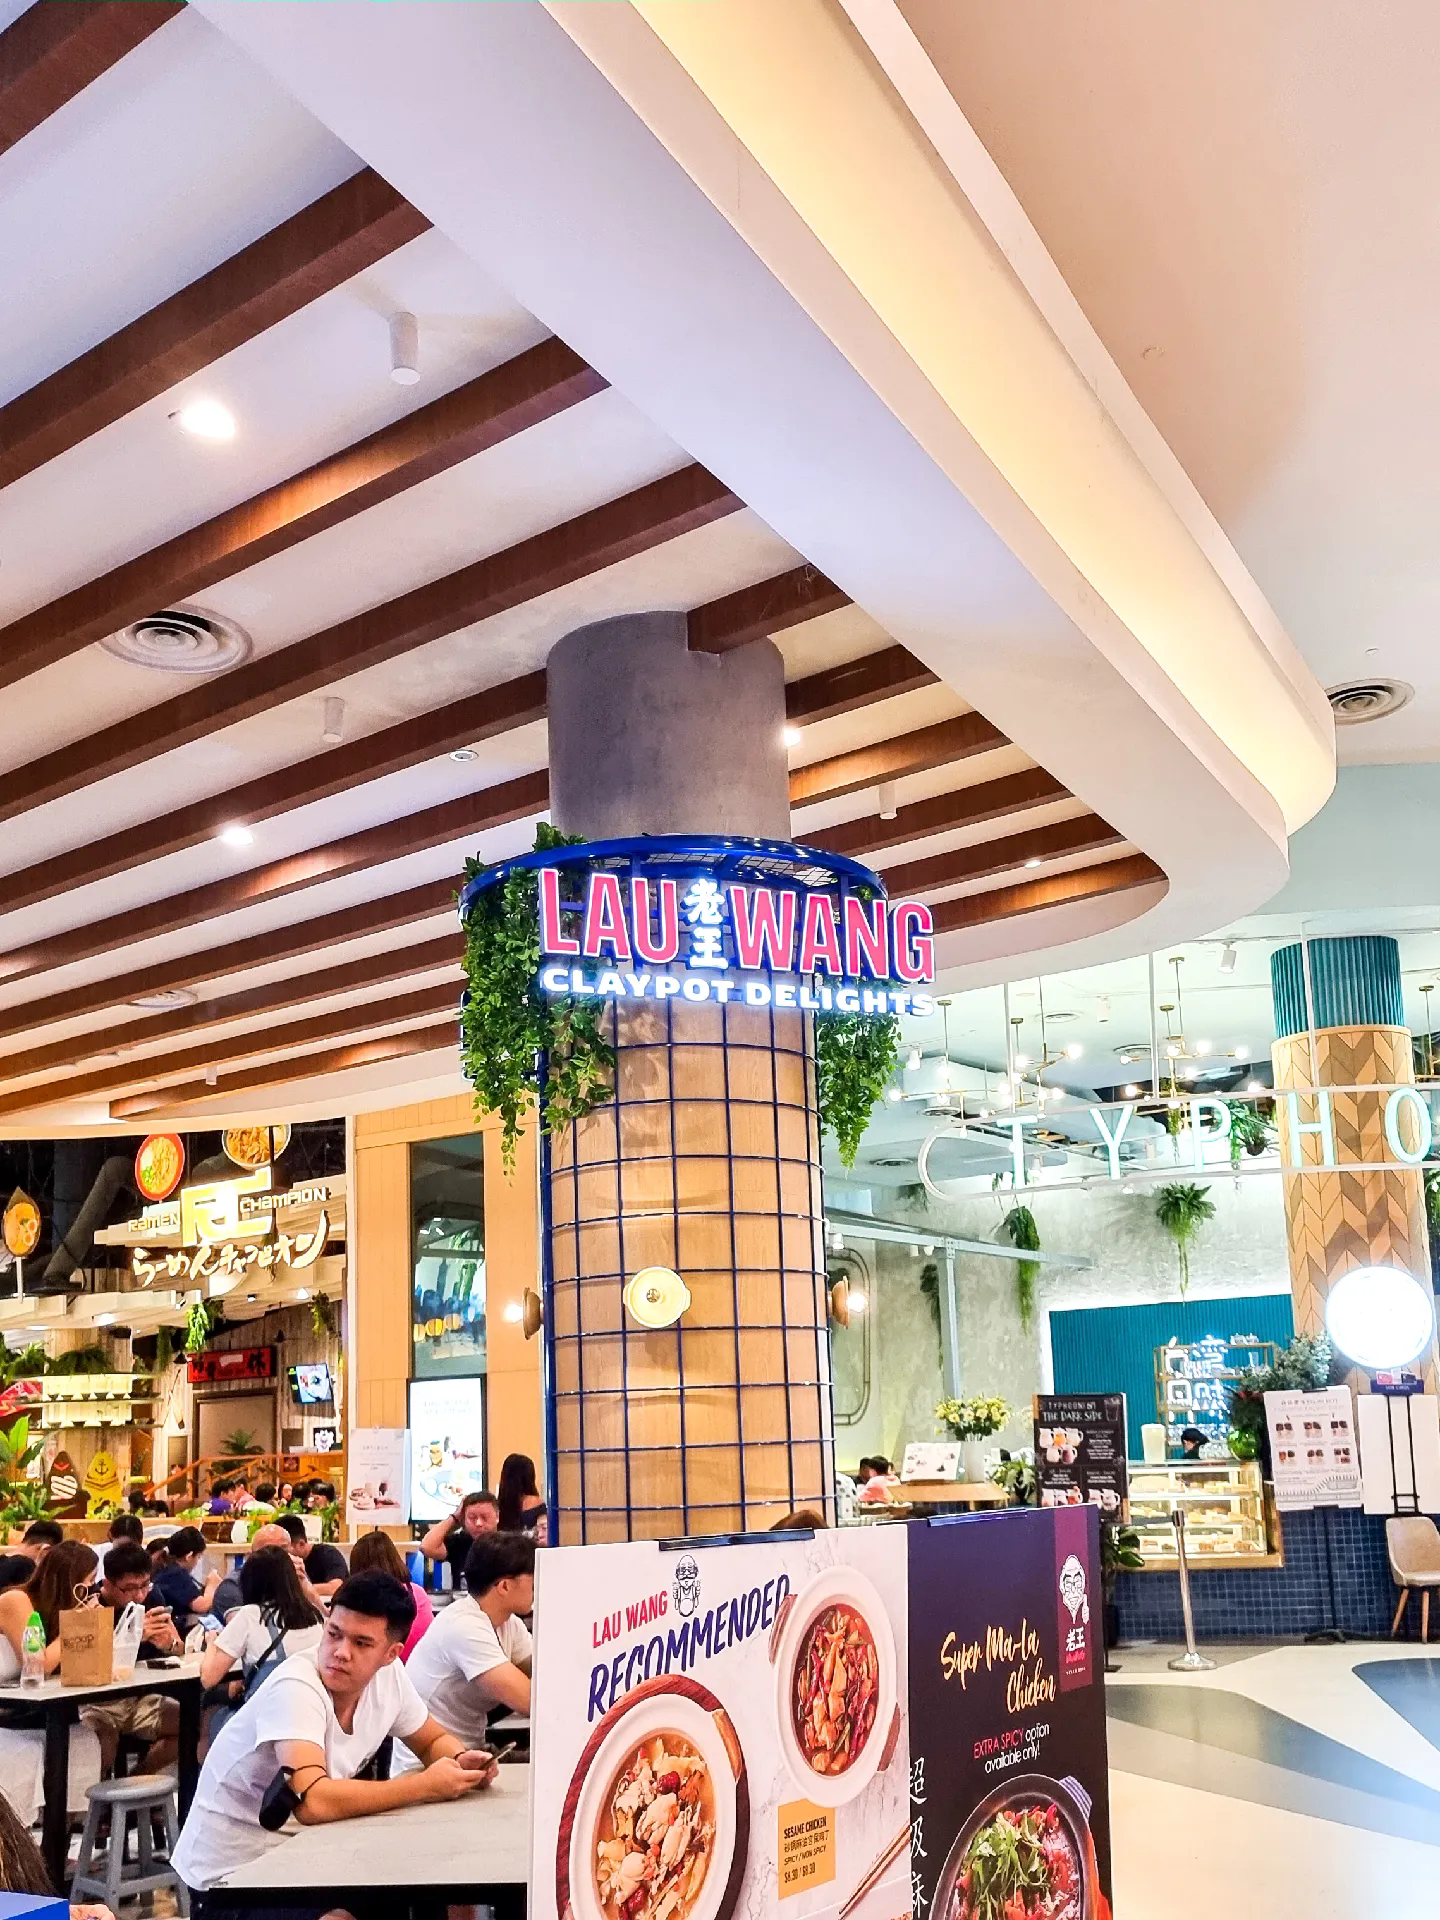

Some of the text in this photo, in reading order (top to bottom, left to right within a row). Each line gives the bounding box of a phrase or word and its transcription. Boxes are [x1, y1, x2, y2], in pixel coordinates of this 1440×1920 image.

[538, 868, 936, 984] LAU WANG
[683, 878, 730, 971] 老王
[543, 968, 935, 1016] CLAYPOT DELIGHTS
[592, 1590, 668, 1648] LAU WANG
[1065, 1625, 1086, 1652] 老王
[587, 1574, 790, 1722] RECOMMENDED
[940, 1631, 983, 1690] Super
[1006, 1657, 1056, 1714] Chicken
[973, 1722, 1050, 1759] EXTRA SPICY option
[984, 1748, 1022, 1774] available
[783, 1815, 827, 1840] SESAME CHICKEN
